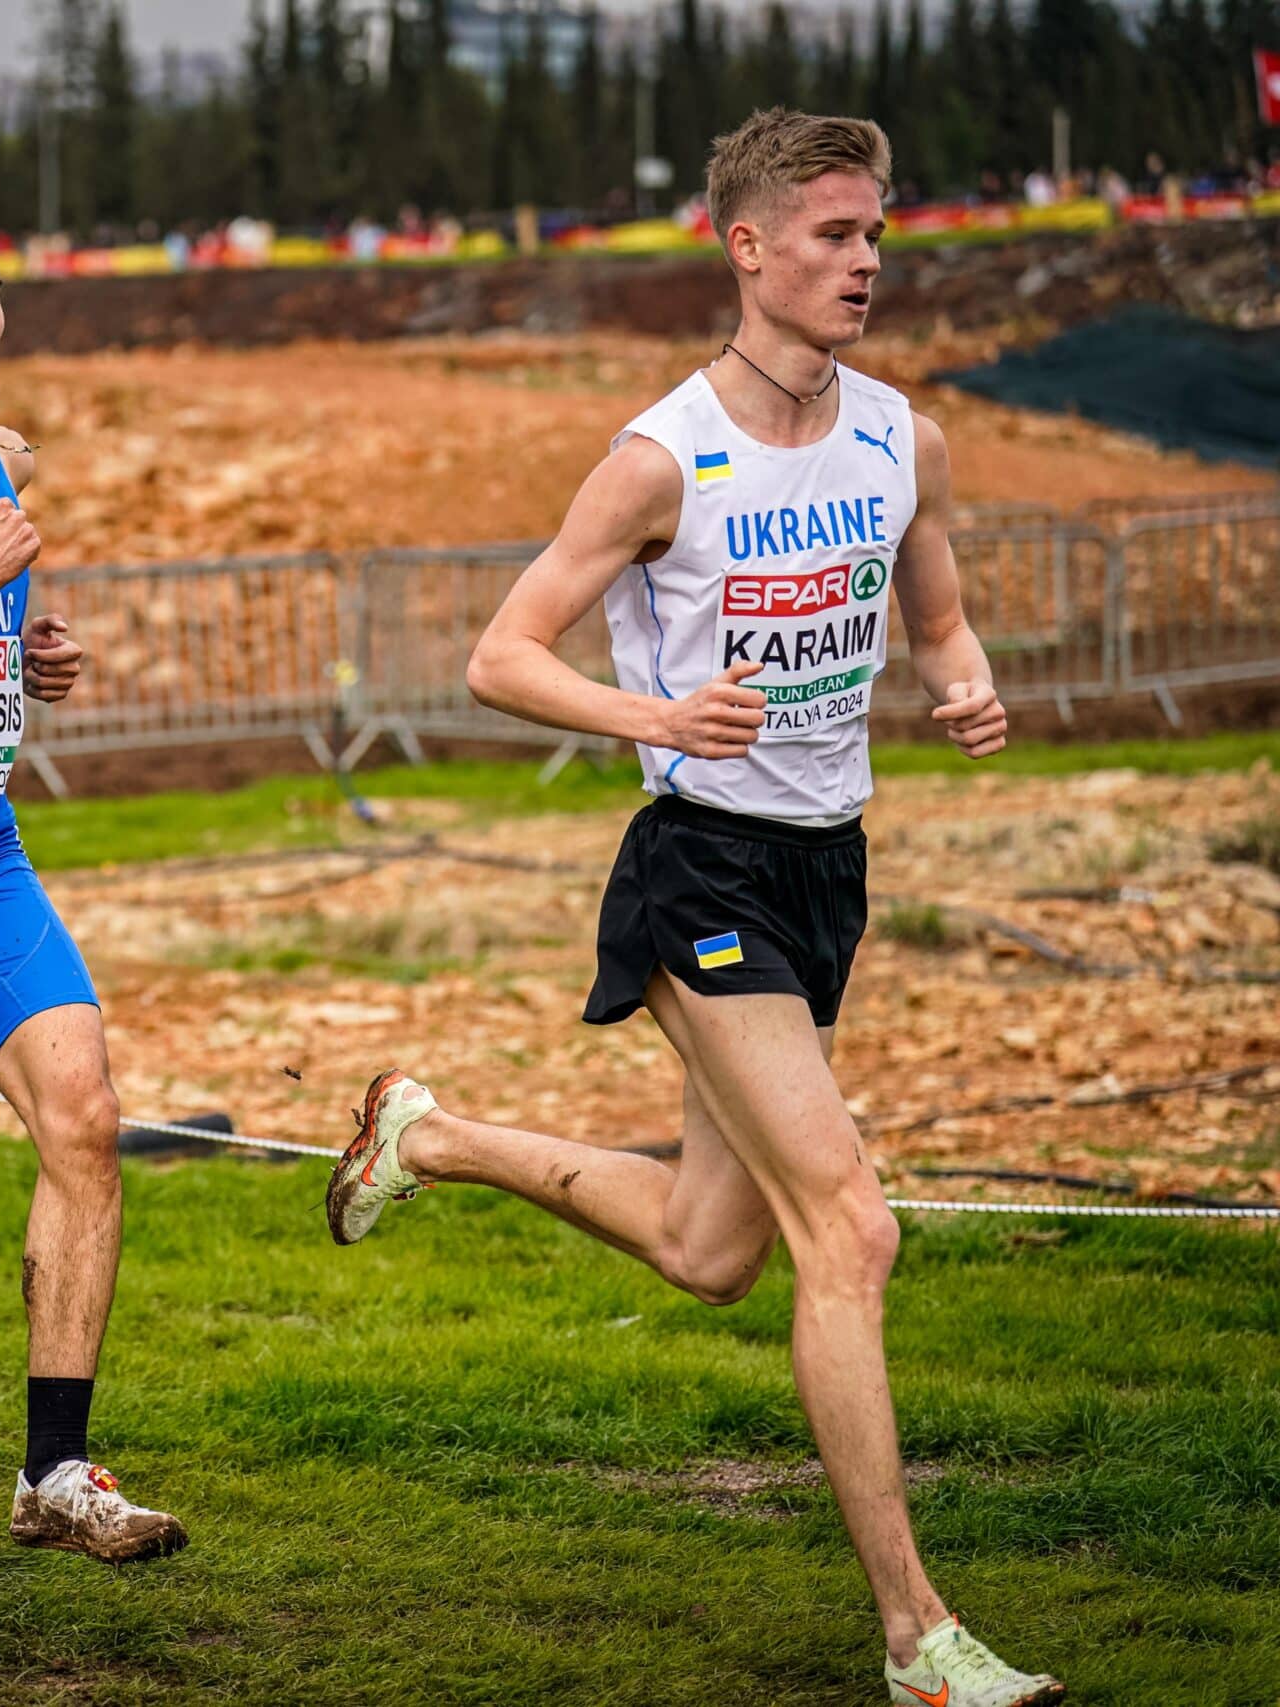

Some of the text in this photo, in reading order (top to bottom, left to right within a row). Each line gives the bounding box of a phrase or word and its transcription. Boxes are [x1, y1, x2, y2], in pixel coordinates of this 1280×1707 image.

[726, 497, 886, 560] UKRAINE
[727, 570, 846, 611] SPAR
[723, 612, 877, 672] KARAIM
[764, 690, 863, 729] TALYA 2024
[766, 677, 846, 702] RUN CLEAN
